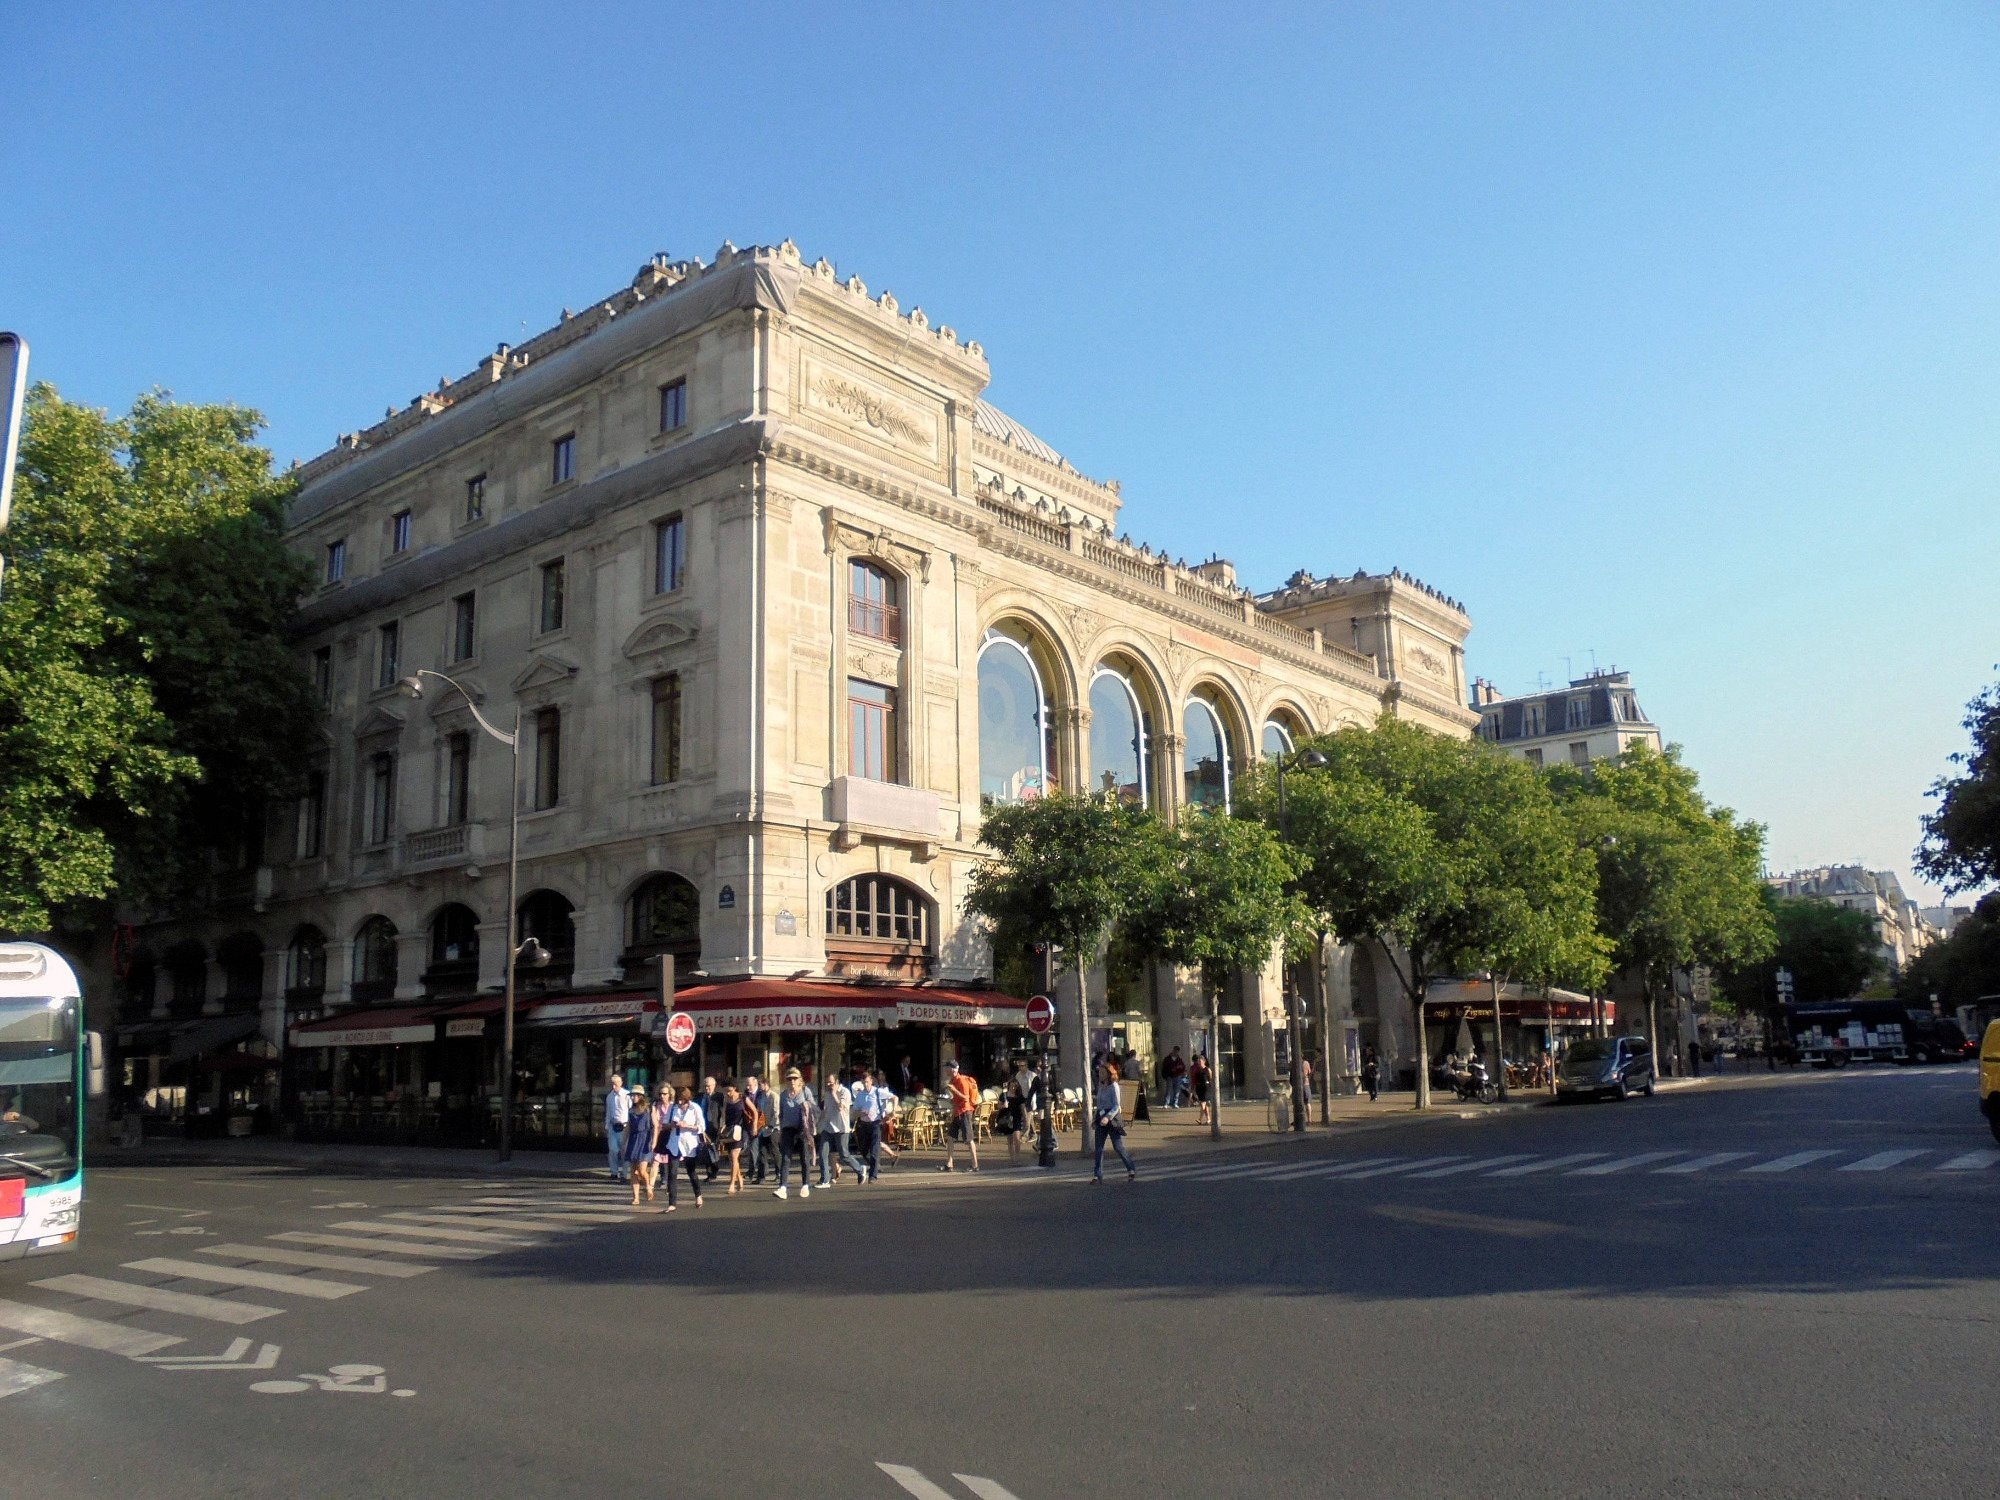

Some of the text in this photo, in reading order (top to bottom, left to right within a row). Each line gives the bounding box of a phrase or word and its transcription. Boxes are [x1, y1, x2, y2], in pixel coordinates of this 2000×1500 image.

[852, 1014, 872, 1024] PIZZA
[909, 1006, 939, 1020] BORDS
[941, 1008, 952, 1020] DE
[697, 1013, 837, 1029] CAFE BAR RESTAURANT
